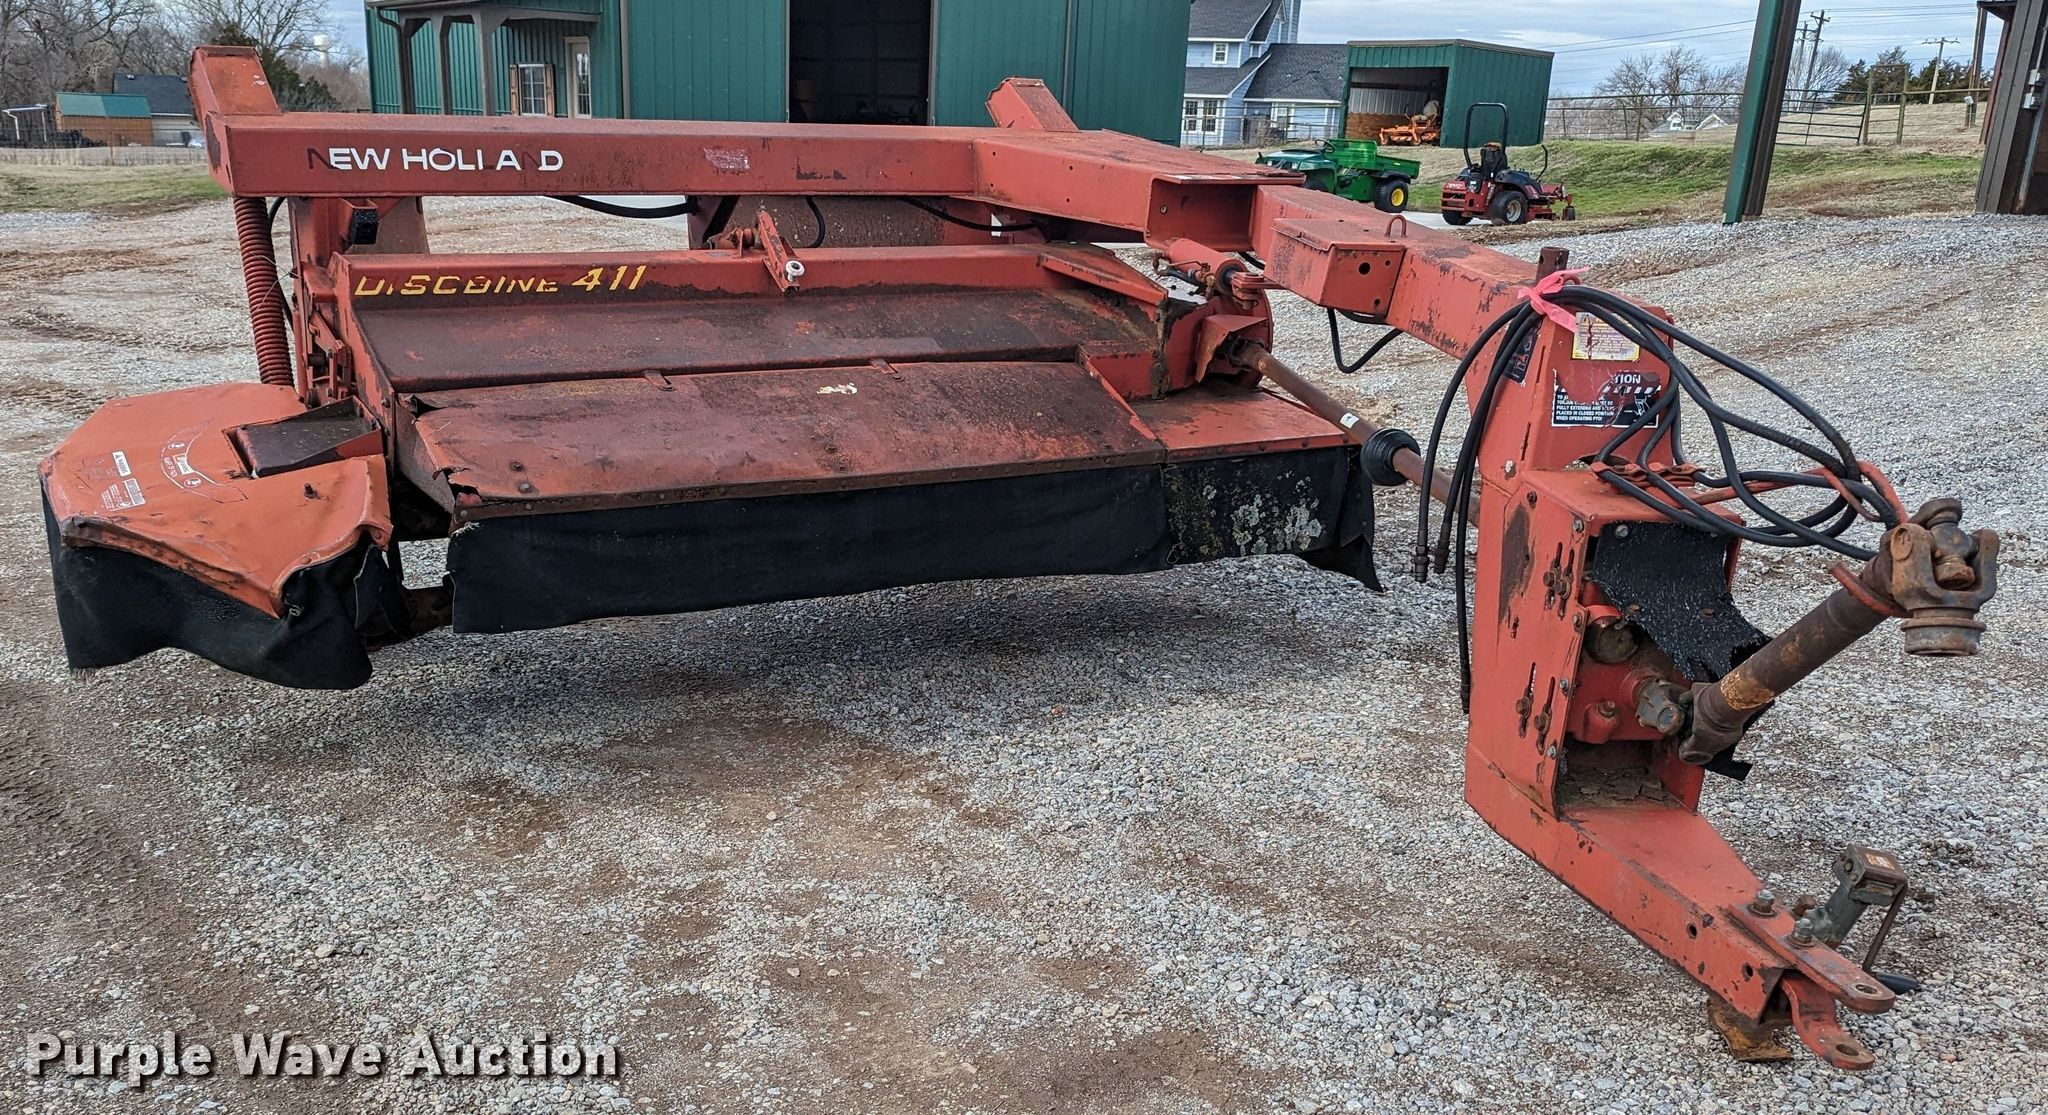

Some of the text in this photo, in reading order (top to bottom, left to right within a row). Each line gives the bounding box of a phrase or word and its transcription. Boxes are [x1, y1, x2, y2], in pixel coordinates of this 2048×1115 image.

[307, 147, 564, 171] NEW HOLLAND
[571, 264, 647, 291] 411
